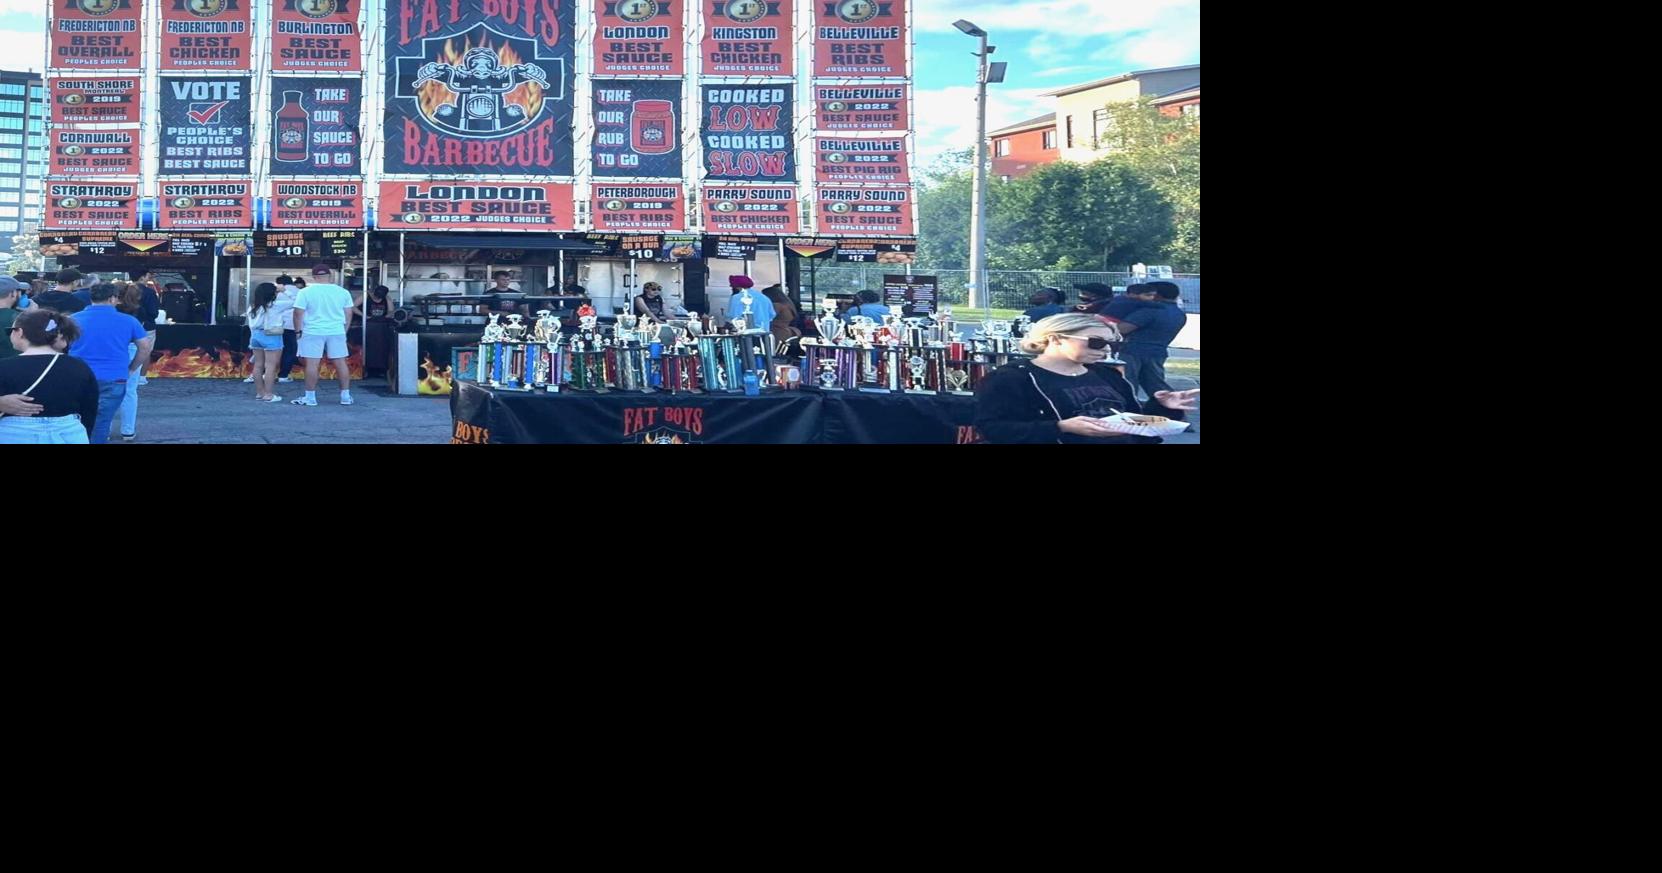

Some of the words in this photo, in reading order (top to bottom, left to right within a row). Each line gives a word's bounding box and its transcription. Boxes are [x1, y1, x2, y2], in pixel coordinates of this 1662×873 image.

[59, 19, 120, 32] FREDERICTON
[122, 19, 136, 32] NB
[167, 21, 228, 33] FREDERICTON
[230, 21, 244, 33] NB
[278, 21, 353, 34] BURLINGTON
[603, 27, 669, 39] LONDON
[713, 27, 776, 39] KINGSTON
[820, 27, 899, 39] BELLEVILLE
[71, 35, 124, 46] BEST
[179, 36, 232, 47] BEST
[289, 37, 342, 48] BEST
[58, 46, 134, 57] OVERALL
[169, 47, 240, 58] CHICKEN
[610, 42, 663, 52] BEST
[718, 42, 772, 52] BEST
[831, 43, 884, 53] BEST
[280, 48, 351, 59] SAUCE
[602, 53, 673, 63] SAUCE
[710, 53, 782, 64] CHICKEN
[831, 54, 884, 65] RIBS
[58, 81, 94, 89] SOUTH
[97, 80, 133, 89] SHORE
[171, 81, 240, 100] VOTE
[314, 88, 347, 102] TAKE
[598, 89, 631, 103] TAKE
[708, 89, 784, 103] COOKED
[819, 88, 902, 99] BELLEVILLE
[92, 95, 121, 103] 2019
[62, 106, 89, 115] BEST
[92, 106, 127, 115] SAUCE
[313, 110, 341, 123] OUR
[597, 111, 624, 124] OUR
[708, 105, 782, 131] LOW
[822, 114, 851, 122] BEST
[855, 113, 899, 121] SAUCE
[167, 127, 243, 135] PEOPLE'S
[59, 132, 131, 143] CORNWALL
[176, 136, 234, 144] CHOICE
[313, 131, 354, 145] SAUCE
[402, 116, 555, 167] BARBECUE
[597, 132, 624, 146] RUB
[707, 135, 785, 149] COOKED
[166, 146, 203, 156] BEST
[207, 146, 243, 156] RIBS
[820, 140, 900, 151] BELLEVILLE
[57, 158, 88, 166] BEST
[92, 158, 133, 166] SAUCE
[164, 159, 200, 169] BEST
[203, 159, 245, 168] SAUCE
[313, 152, 330, 166] TO
[333, 152, 352, 166] GO
[597, 153, 615, 167] TO
[619, 153, 639, 167] GO
[709, 150, 787, 176] SLOW
[822, 165, 851, 173] BEST
[52, 185, 132, 196] STRATHROY
[165, 184, 245, 196] STRATHROY
[278, 185, 340, 195] WOODSTOCK
[343, 185, 356, 195] NB
[407, 185, 545, 201] LONDON
[598, 187, 676, 198] PETERBOROUGH
[707, 189, 746, 199] PARRY
[750, 189, 791, 200] SOUND
[821, 190, 860, 200] PARRY
[864, 190, 905, 201] SOUND
[401, 202, 462, 213] BEST
[471, 202, 550, 213] SAUCE
[53, 210, 84, 219] BEST
[88, 211, 129, 219] SAUCE
[168, 210, 203, 218] BEST
[208, 209, 243, 218] RIBS
[278, 211, 304, 219] BEST
[305, 210, 356, 219] OVERALL
[475, 214, 512, 222] JUDGES
[602, 213, 635, 221] BEST
[640, 213, 674, 221] RIBS
[711, 215, 737, 223] BEST
[740, 215, 790, 224] CHICKEN
[825, 215, 855, 223] BEST
[859, 216, 903, 224] SAUCE
[118, 232, 145, 240] ORDER
[277, 246, 302, 255] $10
[629, 249, 653, 258] $10
[623, 407, 658, 436] FAT
[664, 407, 703, 435] BOYS
[455, 421, 489, 443] BOYS
[957, 425, 980, 444] FA
